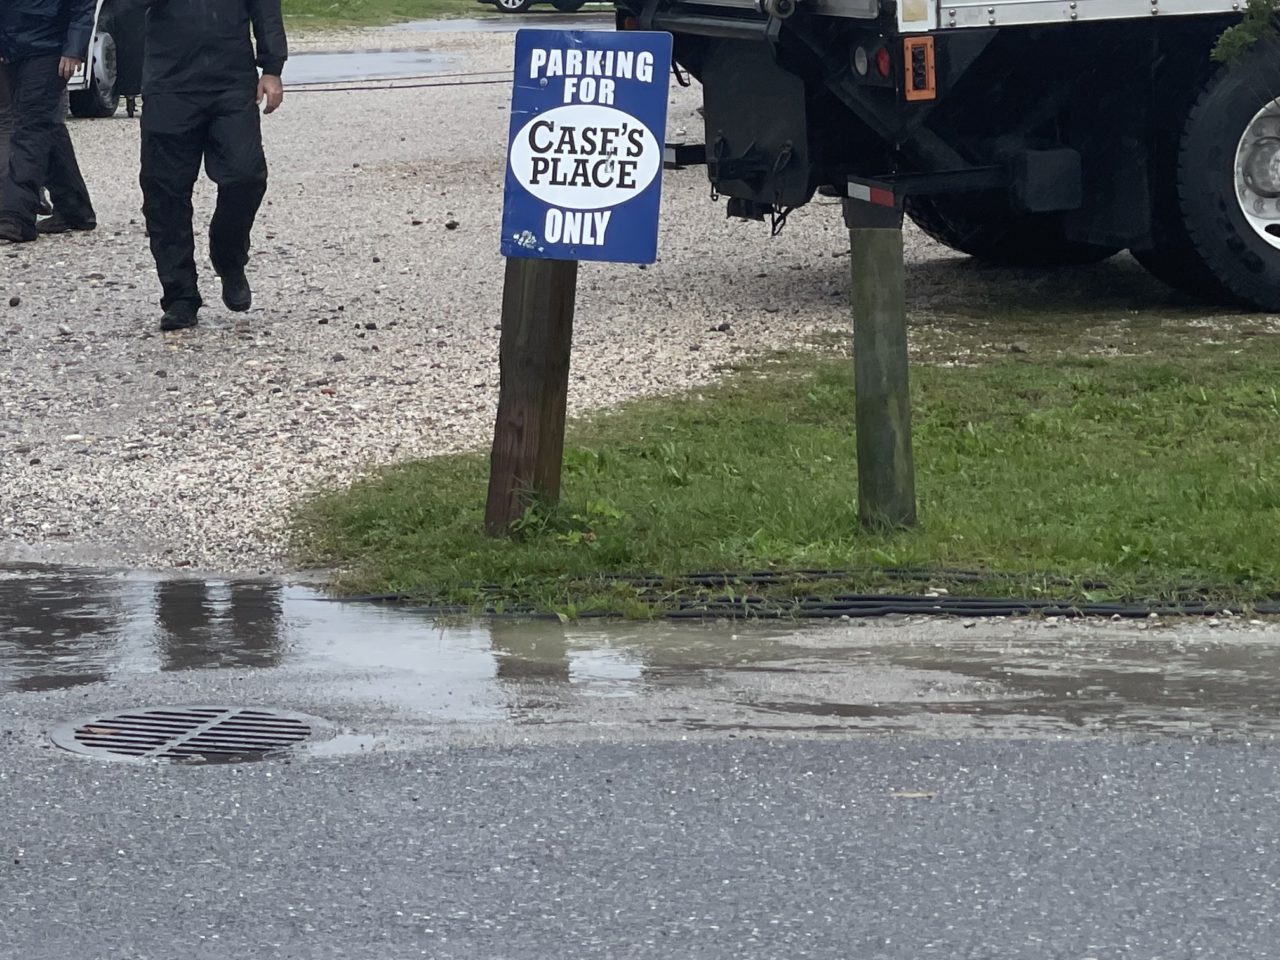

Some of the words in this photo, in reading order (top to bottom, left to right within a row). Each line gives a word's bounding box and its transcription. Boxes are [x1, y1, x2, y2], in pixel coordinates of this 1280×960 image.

[530, 48, 654, 83] PARKING
[563, 77, 615, 105] FOR
[528, 120, 645, 158] CASE'S
[529, 157, 638, 189] PLACE
[544, 208, 611, 246] ONLY
